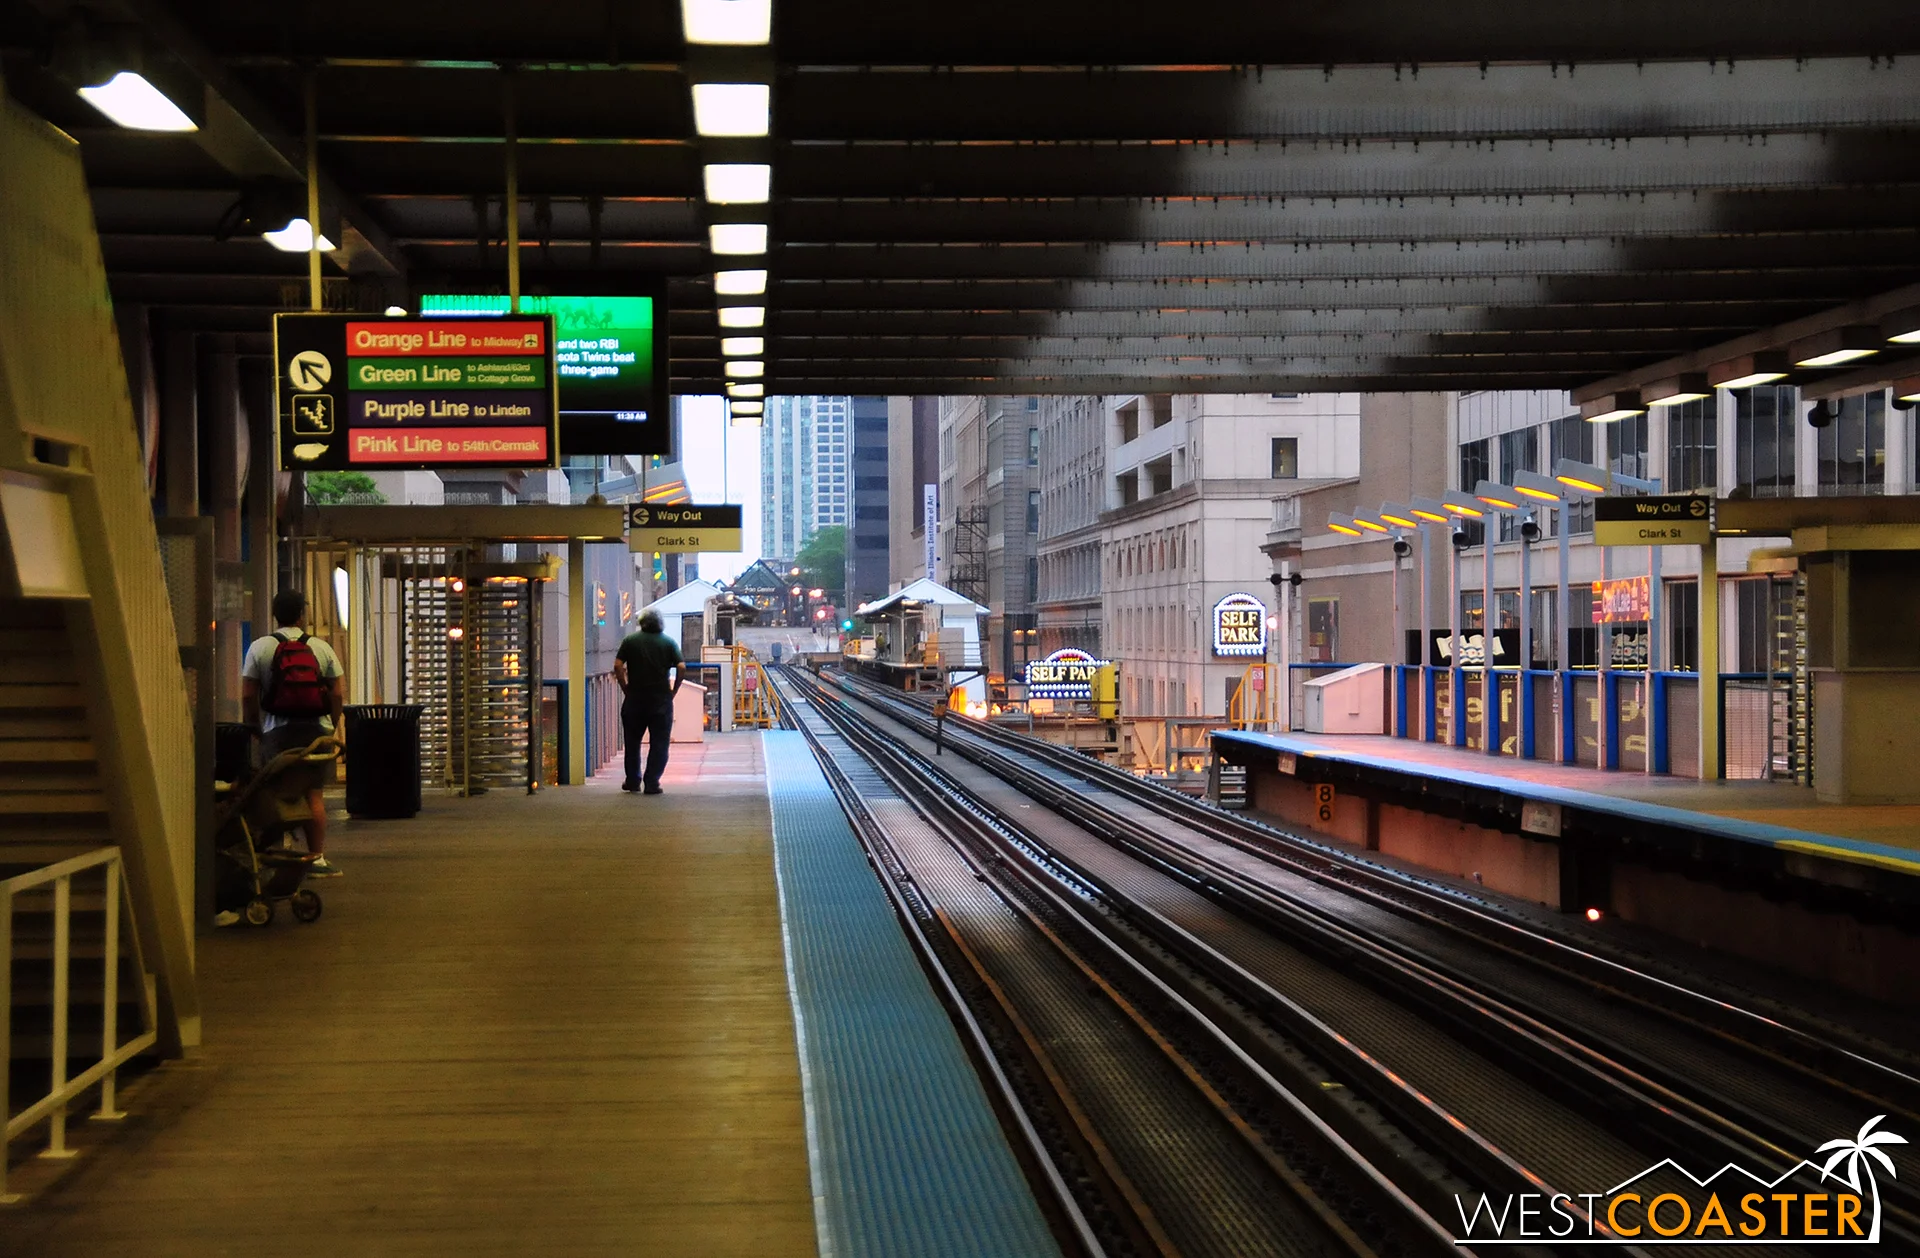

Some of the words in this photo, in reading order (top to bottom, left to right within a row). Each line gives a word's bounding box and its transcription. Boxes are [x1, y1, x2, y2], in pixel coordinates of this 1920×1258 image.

[355, 330, 423, 351] Orange
[428, 330, 466, 348] Line
[471, 338, 481, 346] to
[484, 337, 523, 348] Midway
[557, 339, 577, 349] and
[580, 339, 598, 349] two
[600, 339, 618, 349] RBI
[557, 352, 579, 361] sota
[581, 351, 610, 361] Twins
[612, 352, 635, 362] beat
[359, 365, 416, 382] Green
[422, 365, 461, 382] Line
[467, 364, 476, 372] to
[478, 363, 530, 372] Ashland/63rd
[561, 364, 618, 377] three-game
[478, 374, 510, 384] Cottage
[511, 374, 536, 382] Grove
[364, 400, 425, 421] Purple
[430, 399, 469, 417] Line
[474, 406, 486, 416] to
[490, 405, 531, 416] Linden
[357, 436, 398, 452] Pink
[403, 435, 442, 452] Line
[447, 442, 460, 451] to
[463, 439, 539, 451] 54th/Cermak
[1636, 503, 1659, 515] Way
[1662, 503, 1681, 512] Out
[657, 511, 680, 522] Way
[682, 510, 702, 520] Out
[1638, 529, 1667, 538] Clark
[1670, 529, 1682, 538] St
[657, 536, 685, 546] Clark
[688, 536, 700, 546] St
[1221, 611, 1258, 626] SELF
[1220, 627, 1259, 642] PARK
[1031, 666, 1067, 681] SELF
[1069, 666, 1096, 681] PAR
